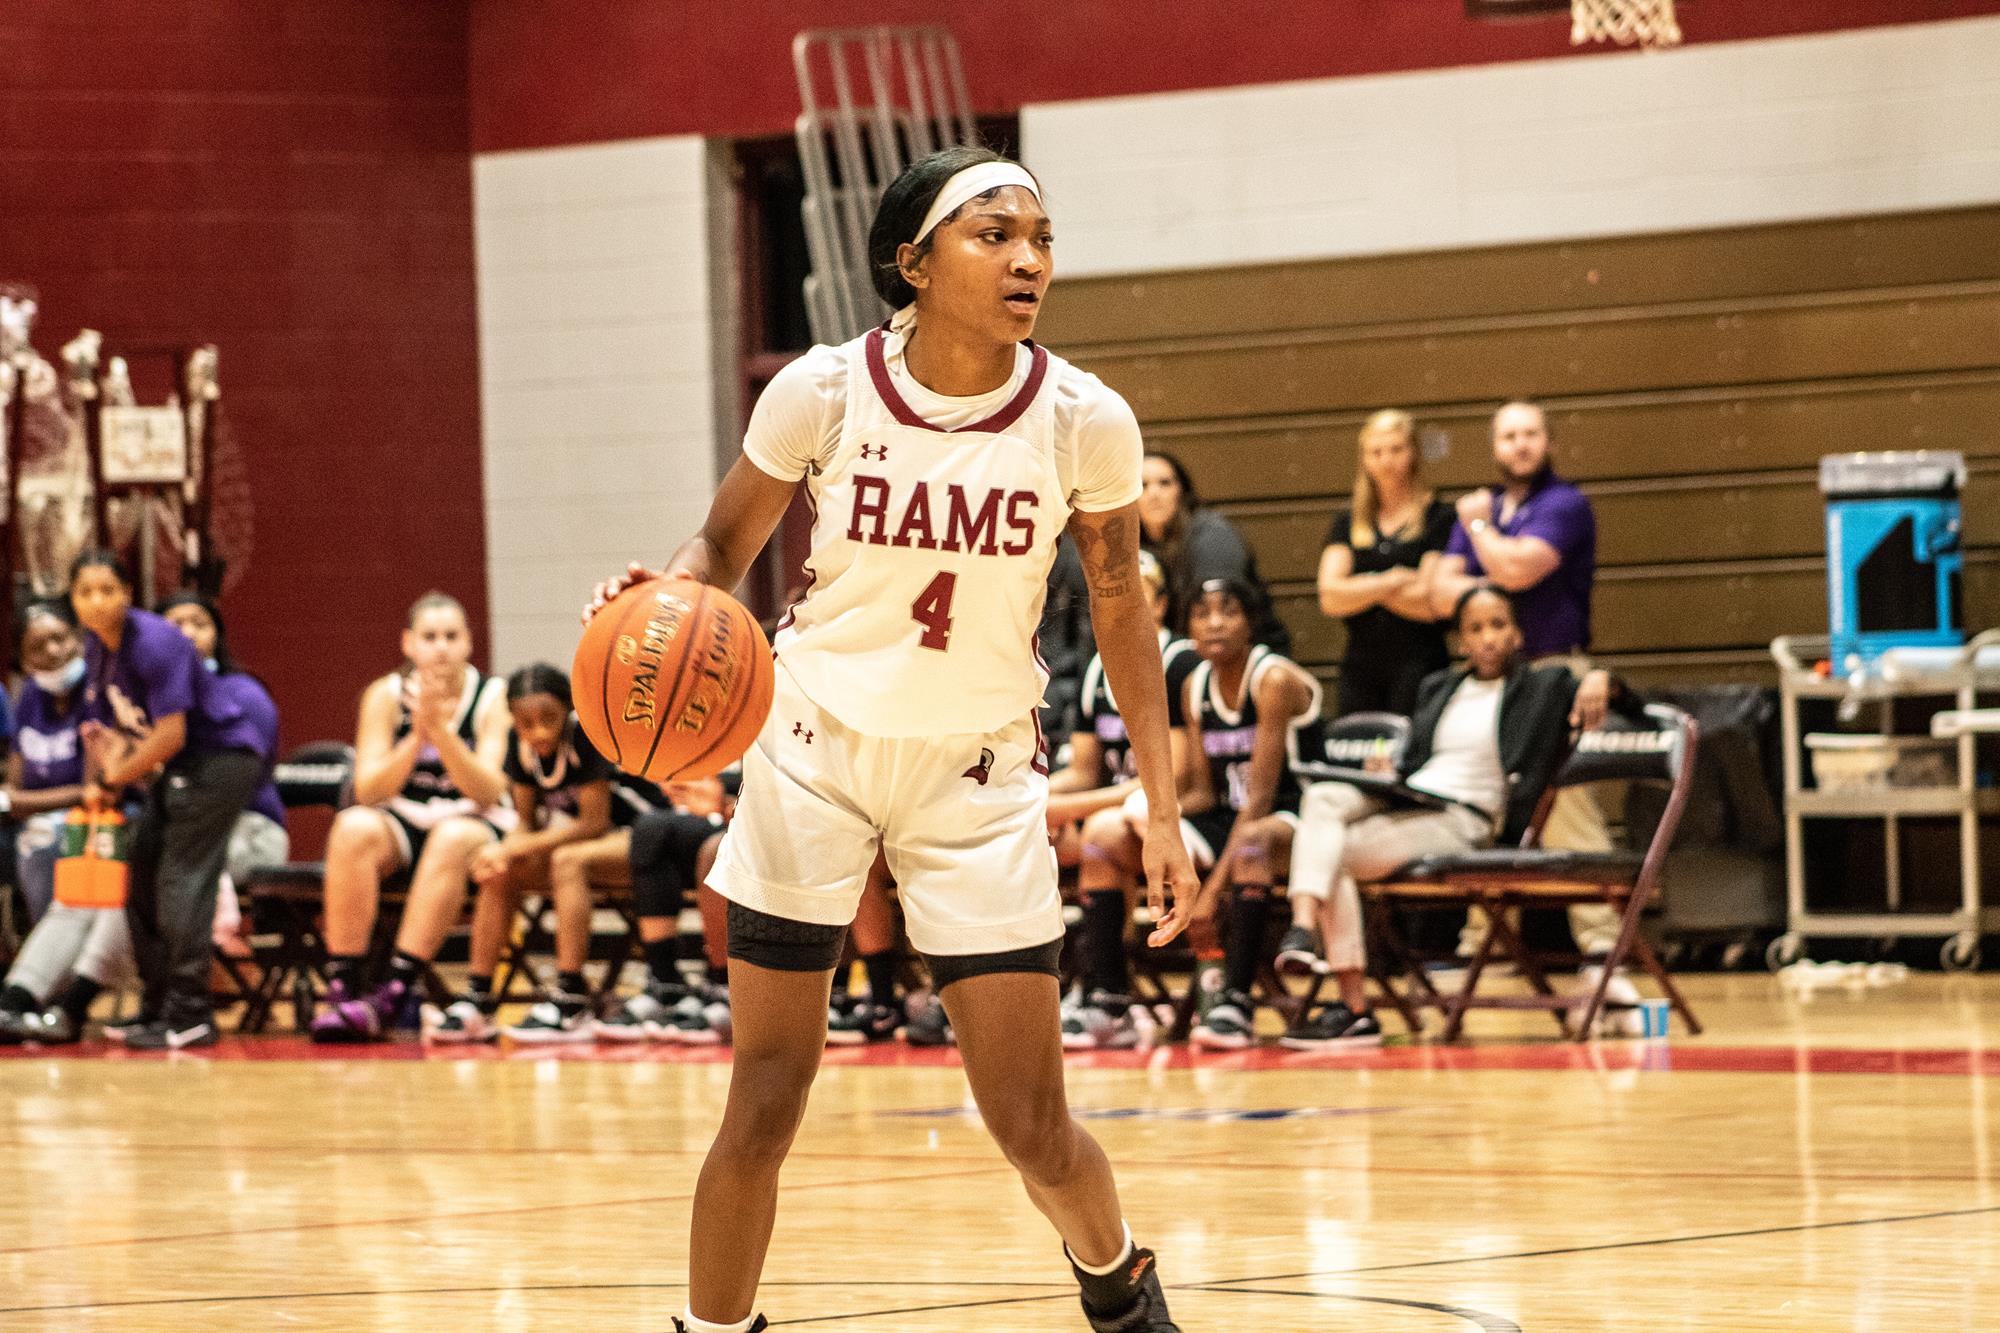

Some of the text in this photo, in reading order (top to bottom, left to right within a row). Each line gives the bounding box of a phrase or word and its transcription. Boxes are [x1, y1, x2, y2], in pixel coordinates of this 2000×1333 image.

[847, 474, 1039, 556] RAMS
[909, 569, 959, 653] 4
[623, 592, 690, 730] SPALDING
